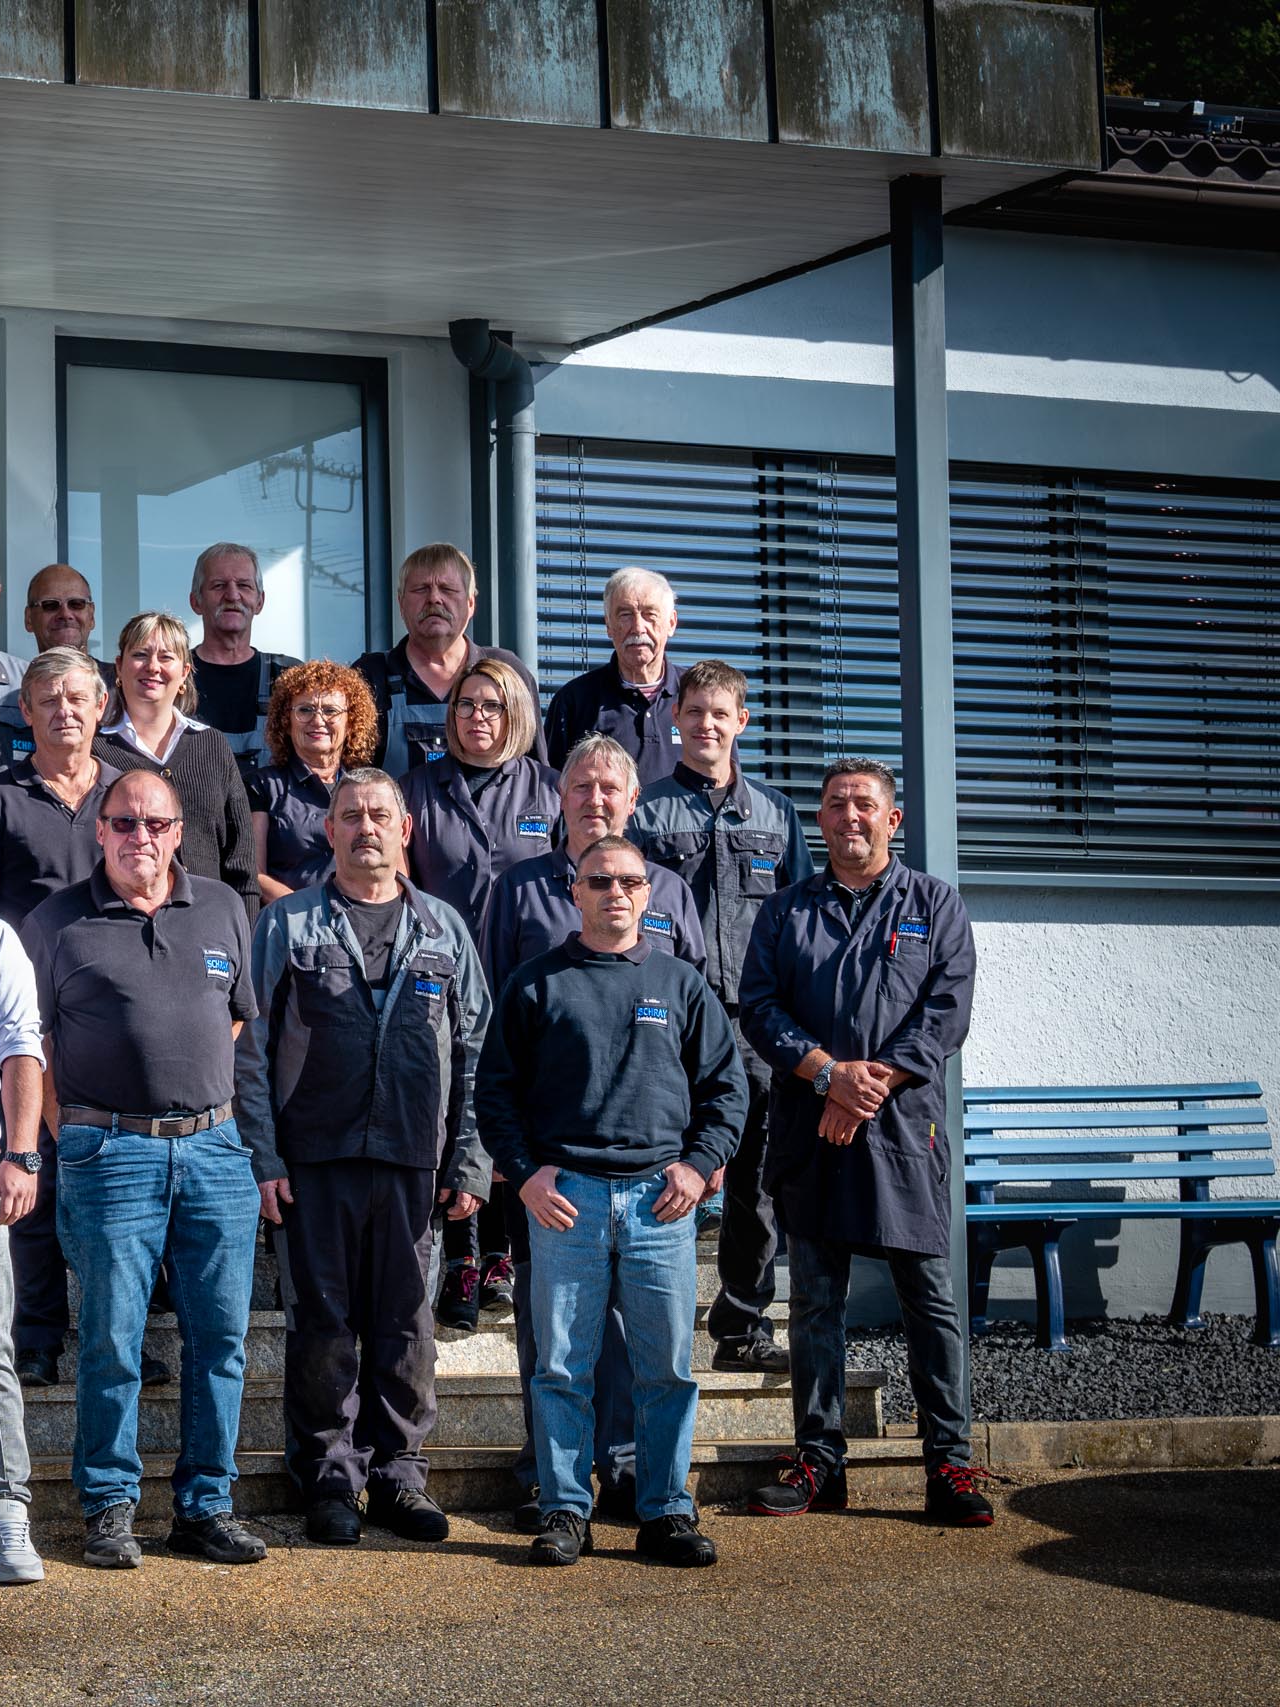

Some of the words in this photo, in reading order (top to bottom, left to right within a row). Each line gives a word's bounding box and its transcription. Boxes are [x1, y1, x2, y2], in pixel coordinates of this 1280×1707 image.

[12, 740, 35, 751] SCHR
[519, 823, 547, 832] SCHRAY
[644, 917, 671, 930] SCHRAY
[900, 924, 928, 933] SCHRAY
[416, 981, 441, 994] SCHRAY
[638, 1008, 667, 1019] SCHRAY
